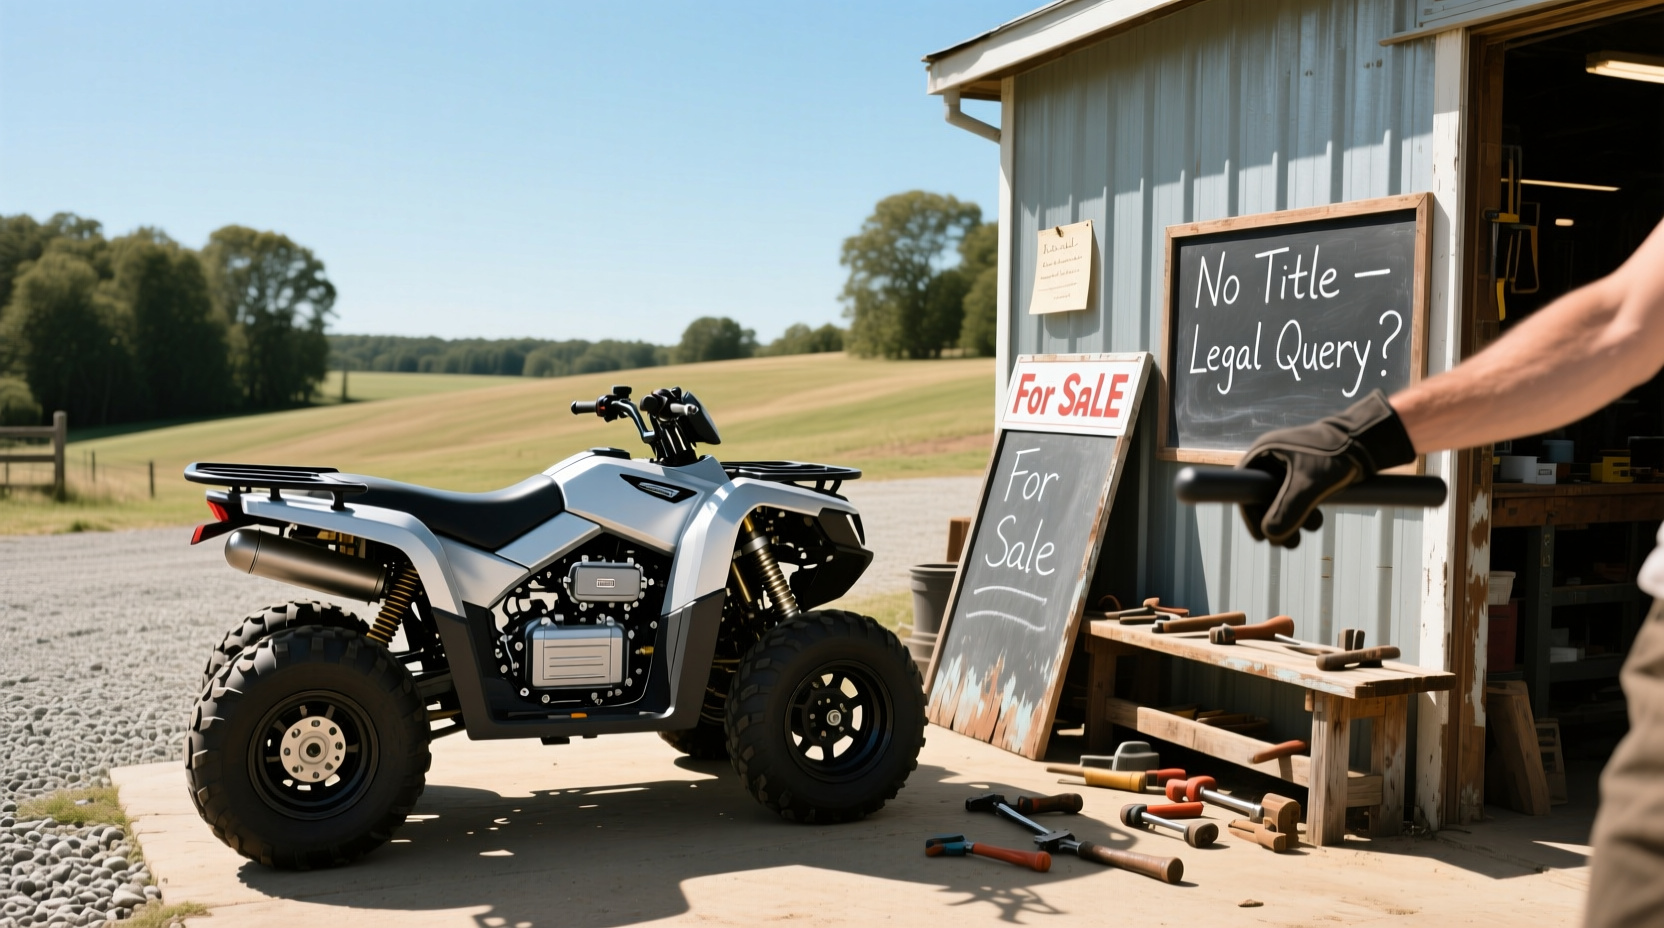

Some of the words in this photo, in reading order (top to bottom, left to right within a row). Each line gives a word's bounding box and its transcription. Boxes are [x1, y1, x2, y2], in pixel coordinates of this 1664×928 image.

[1194, 250, 1240, 309] No
[1254, 244, 1340, 304] Title
[1189, 321, 1262, 395] Legal
[1275, 309, 1403, 398] Query?
[1012, 373, 1056, 415] For
[1003, 447, 1060, 502] For
[984, 514, 1056, 576] Sale
